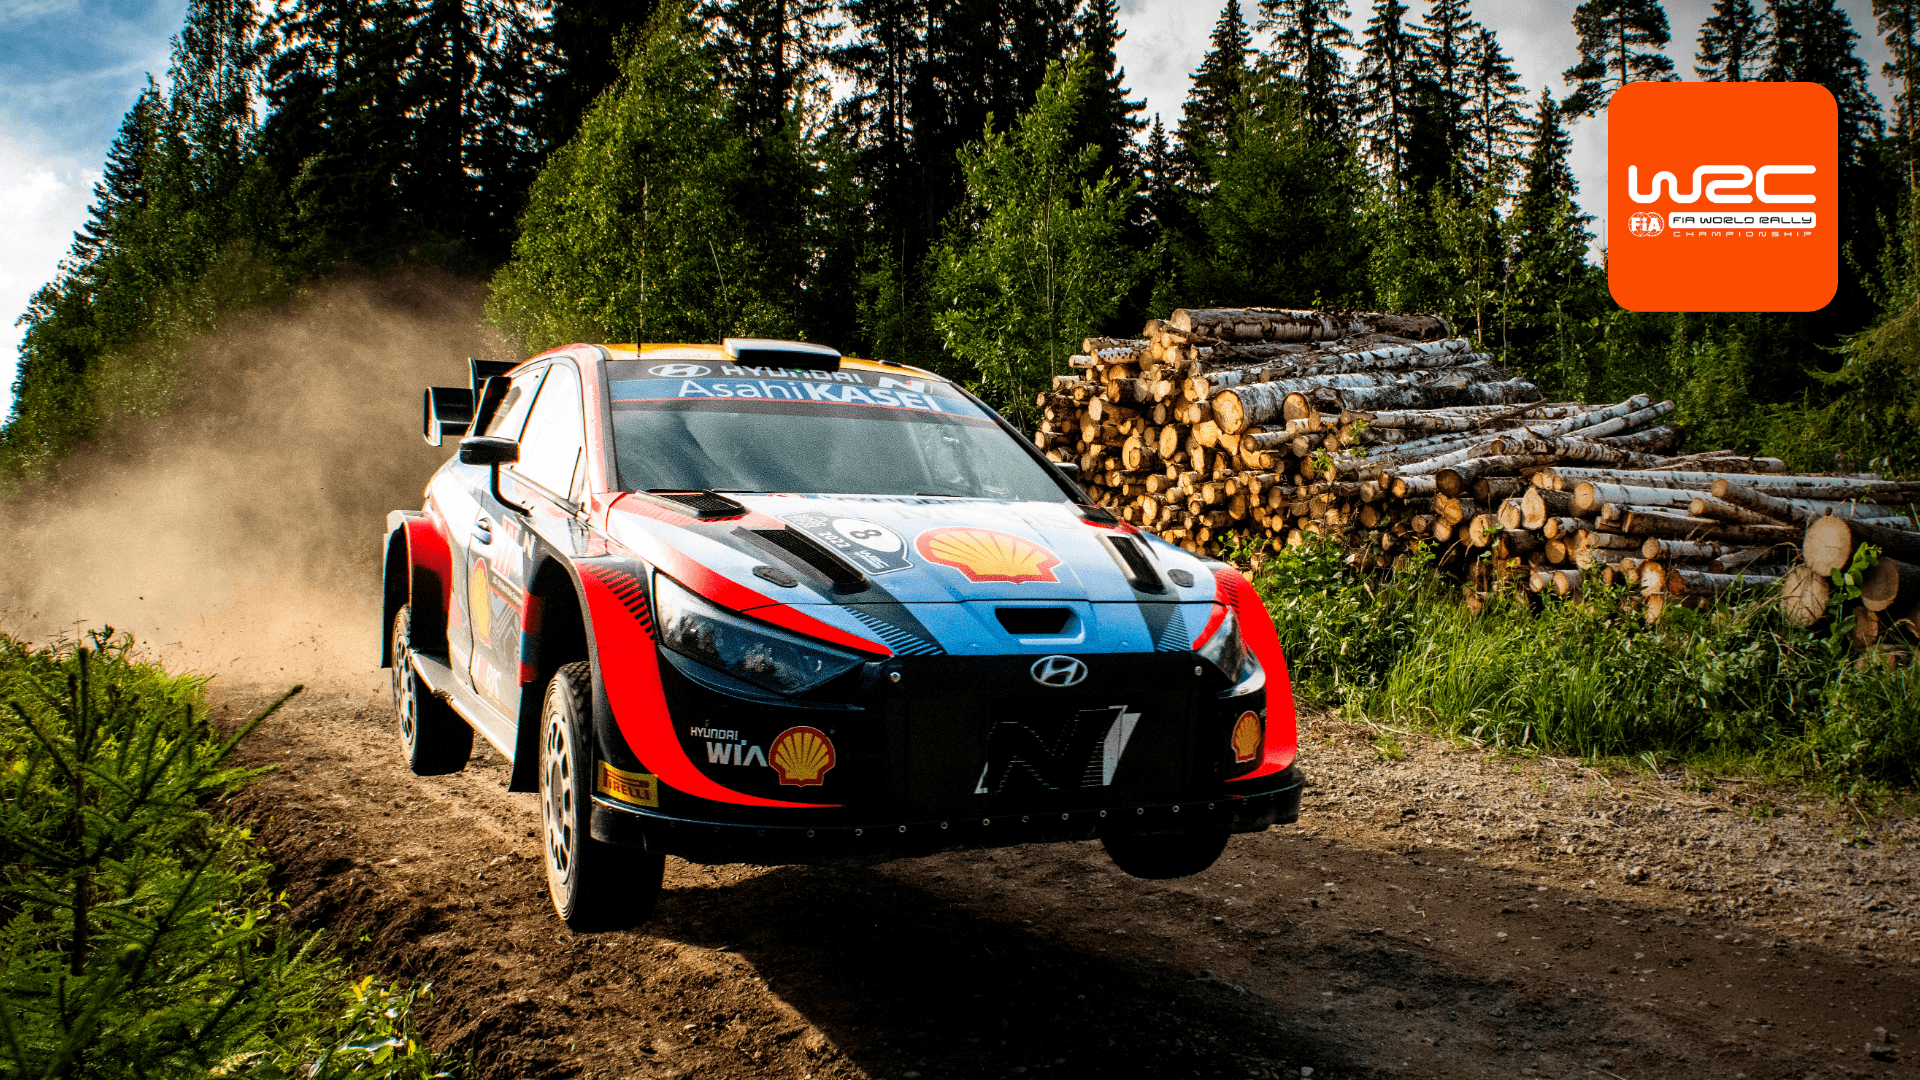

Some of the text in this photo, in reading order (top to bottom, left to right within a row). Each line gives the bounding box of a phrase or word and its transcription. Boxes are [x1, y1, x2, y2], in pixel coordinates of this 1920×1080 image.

[719, 365, 864, 384] HYUNDAI
[849, 529, 882, 540] 8
[690, 726, 739, 741] HYUNDAI
[602, 767, 651, 801] PIRELLI
